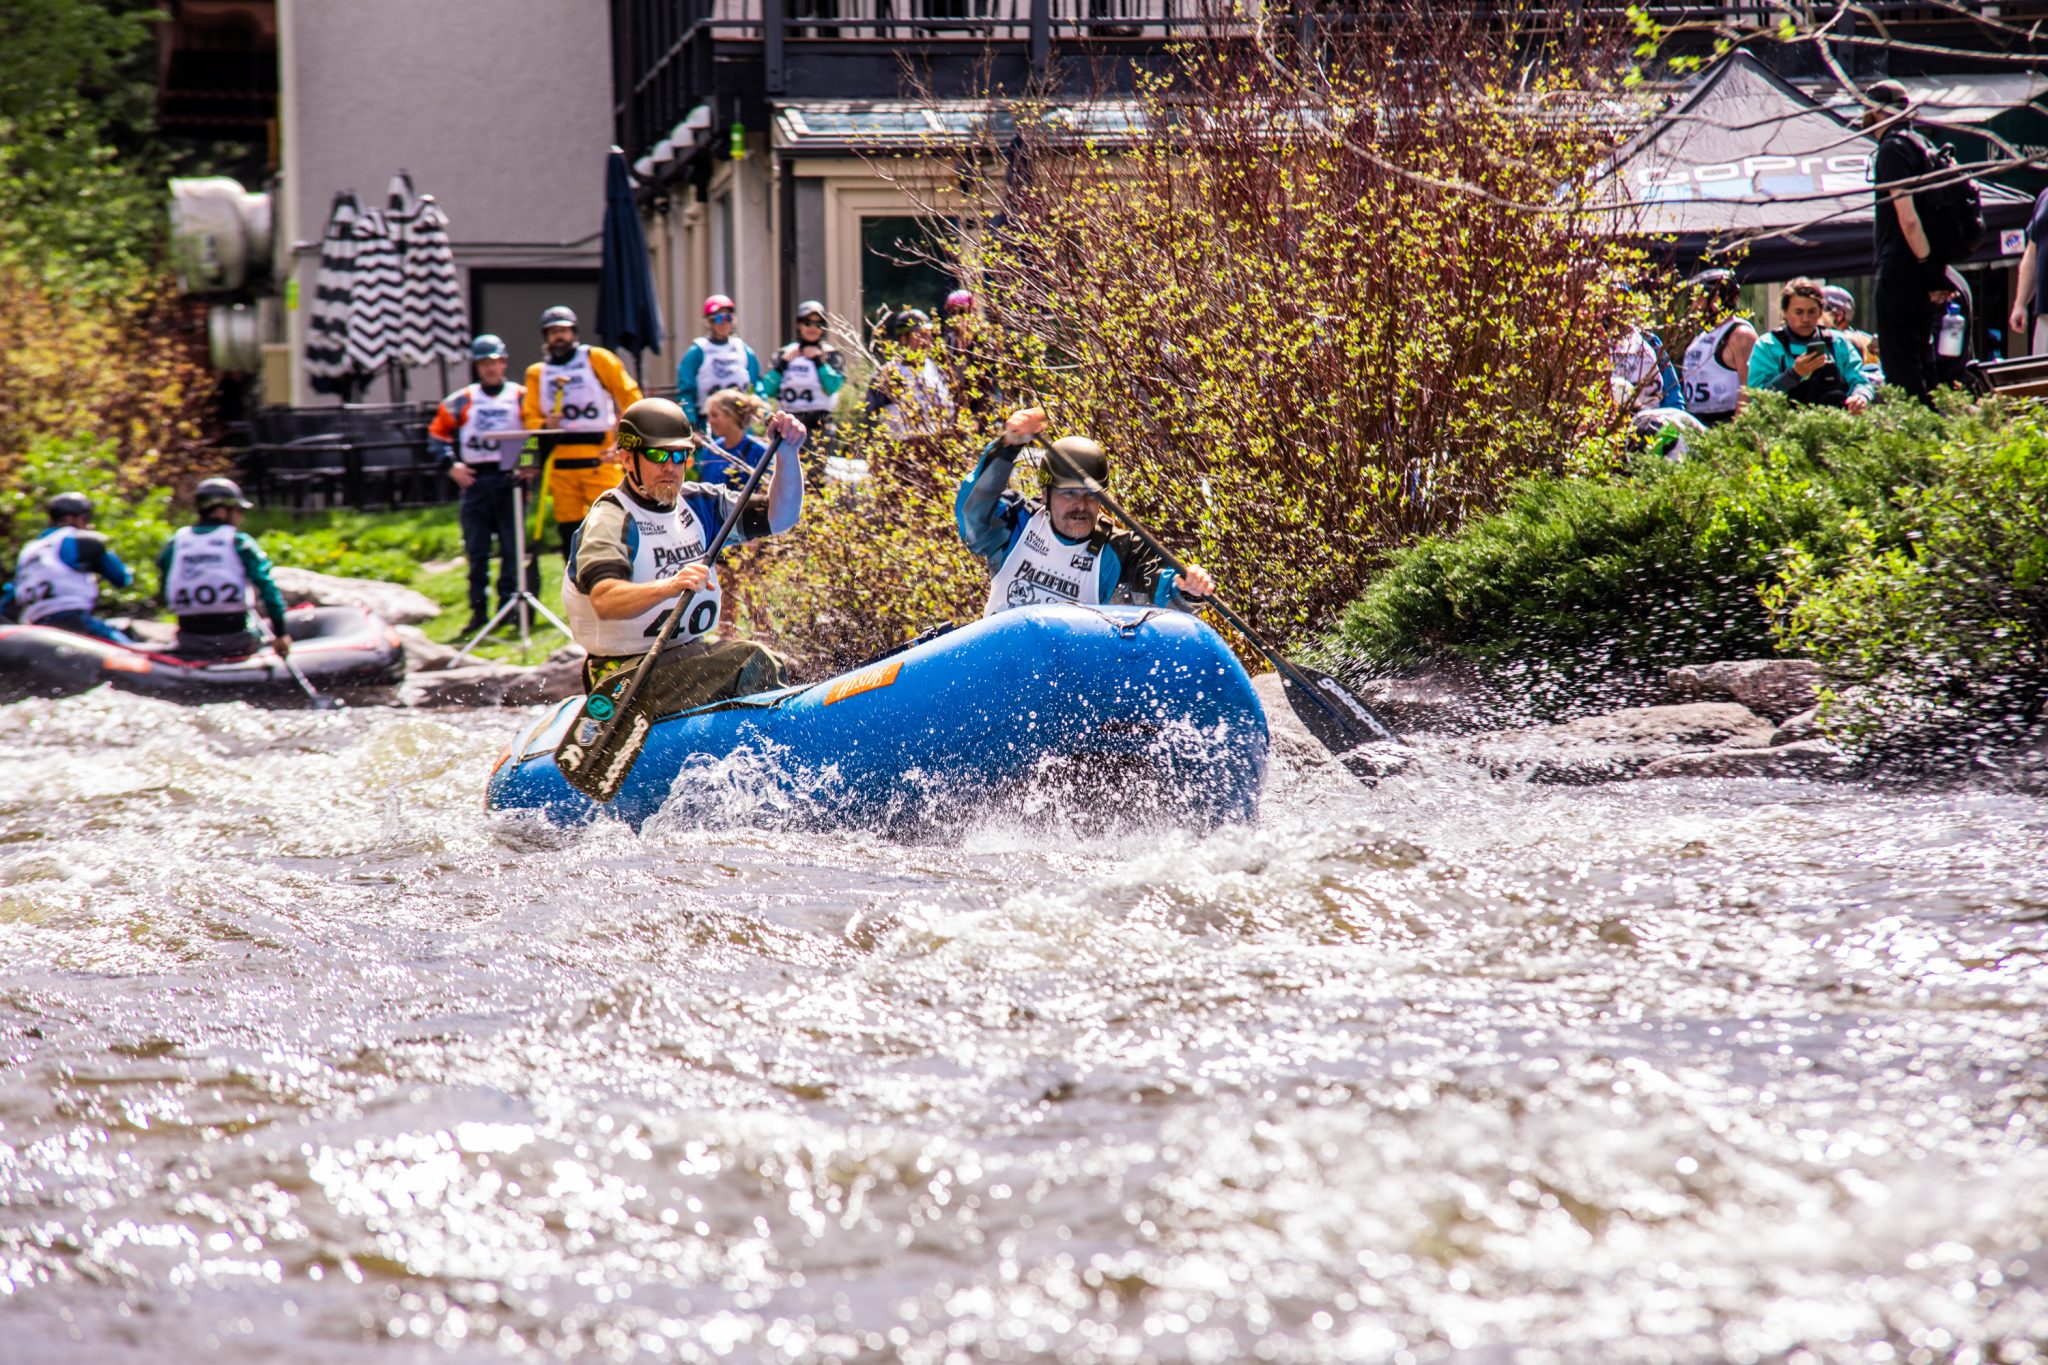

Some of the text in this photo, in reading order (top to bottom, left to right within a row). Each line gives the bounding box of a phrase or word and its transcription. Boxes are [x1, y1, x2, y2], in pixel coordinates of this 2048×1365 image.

[1636, 156, 1873, 187] GoPro
[176, 583, 241, 606] 402
[1014, 559, 1080, 598] PACIFICO
[643, 600, 718, 640] 40
